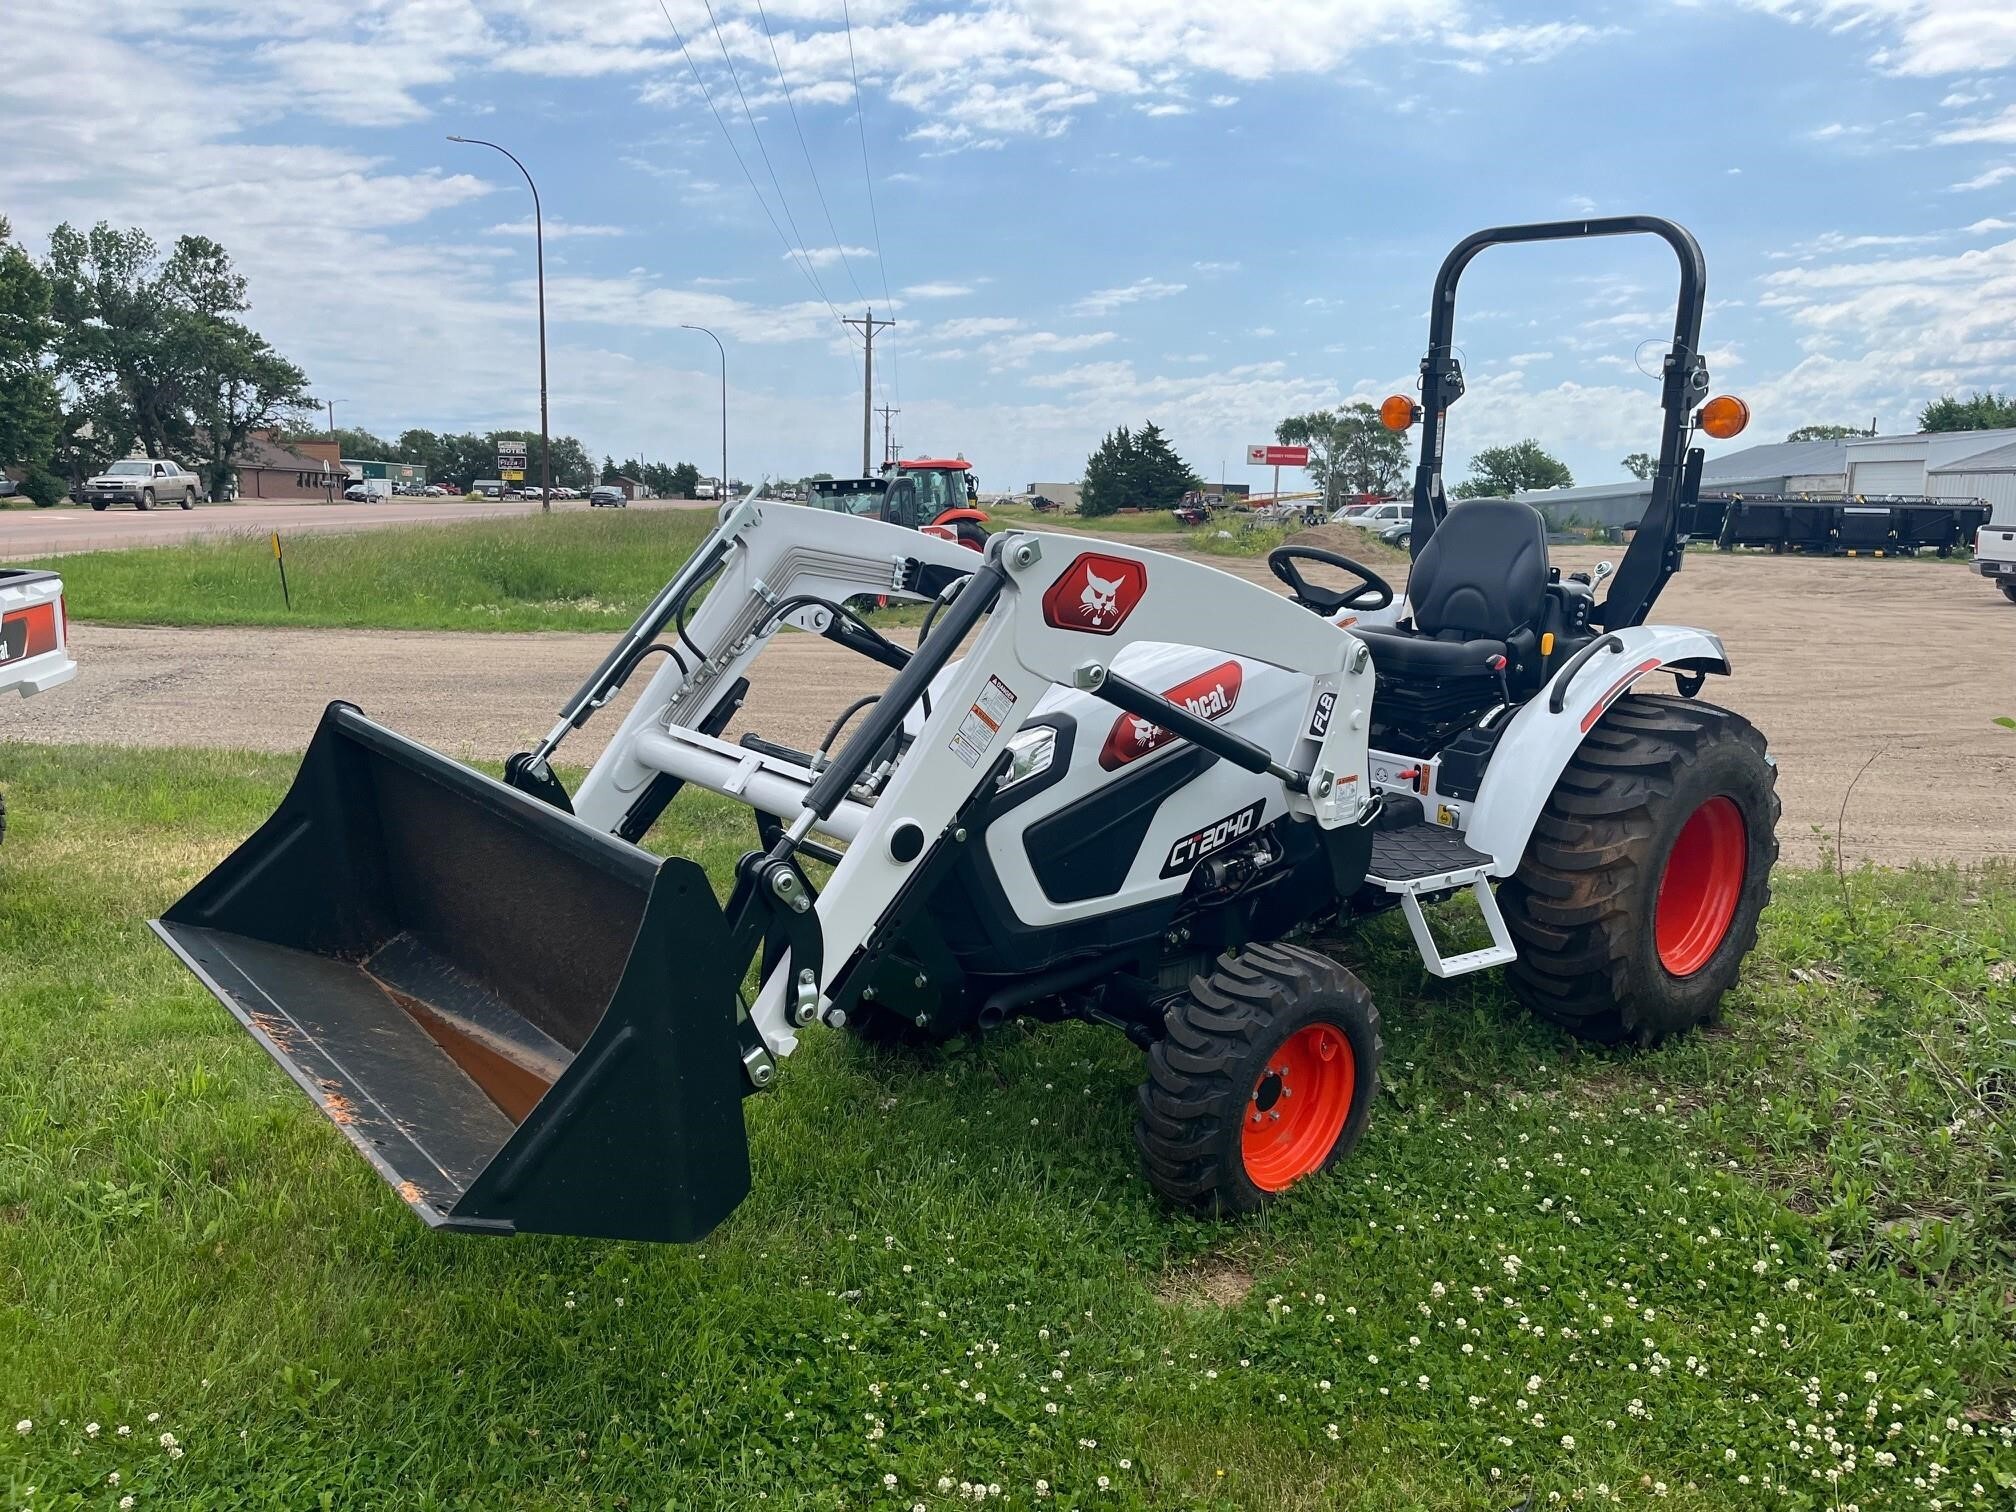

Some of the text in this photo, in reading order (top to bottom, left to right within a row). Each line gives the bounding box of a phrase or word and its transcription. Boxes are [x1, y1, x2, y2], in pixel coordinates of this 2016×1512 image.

[996, 680, 1014, 702] DANGER
[1183, 683, 1227, 718] bcat
[1314, 693, 1334, 734] FL8
[1170, 808, 1254, 868] CT2040
